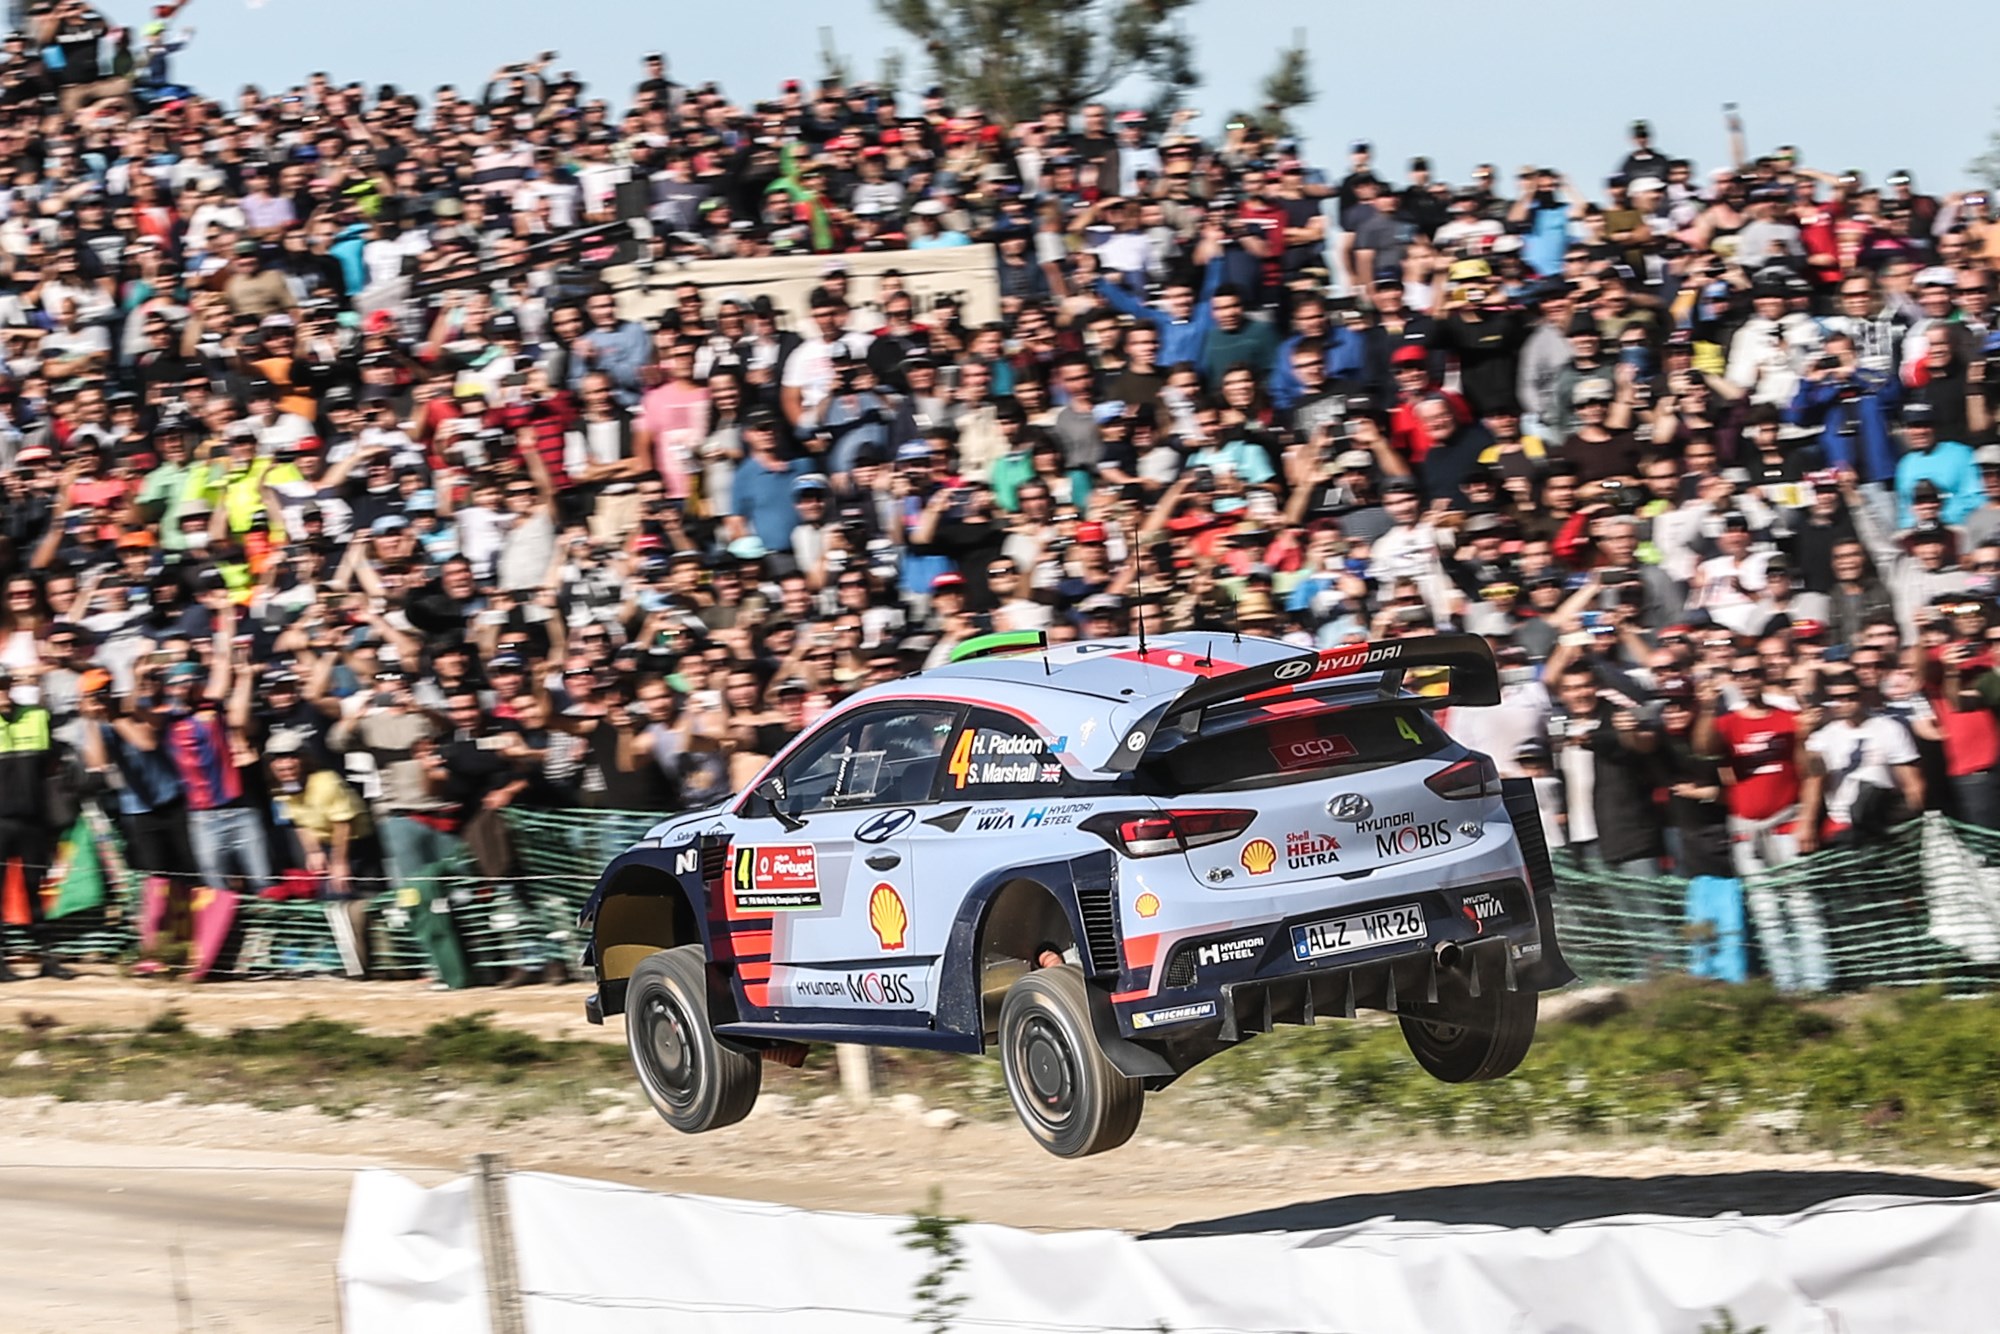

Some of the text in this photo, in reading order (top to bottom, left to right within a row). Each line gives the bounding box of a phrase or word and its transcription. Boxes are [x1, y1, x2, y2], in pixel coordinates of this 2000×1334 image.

[1315, 644, 1402, 673] HYUNDAI
[1394, 716, 1423, 745] 4
[971, 734, 1043, 754] H. Paddon
[1290, 739, 1334, 757] acp
[948, 728, 975, 789] 4
[967, 762, 1037, 783] S. Marshall
[971, 807, 1007, 816] HYUNDAI
[1047, 803, 1094, 815] HYUNDAI
[1041, 815, 1072, 826] STEEL
[1356, 812, 1415, 833] HYUNDAI
[1286, 830, 1310, 843] Shell
[1375, 819, 1452, 858] MOBIS
[1286, 837, 1342, 857] HELIX
[737, 849, 750, 889] 4
[773, 860, 814, 876] Portugal
[1288, 852, 1340, 870] ULTRA
[1462, 893, 1491, 905] HYUNDAI
[1308, 921, 1351, 952] ALZ
[1362, 914, 1394, 941] WR
[1393, 909, 1420, 935] 26
[1220, 937, 1264, 953] HYUNDAI
[1221, 948, 1254, 962] STEEL
[797, 972, 915, 1005] HYUNDAI MOBIS
[1153, 1004, 1211, 1022] MICHELIN
